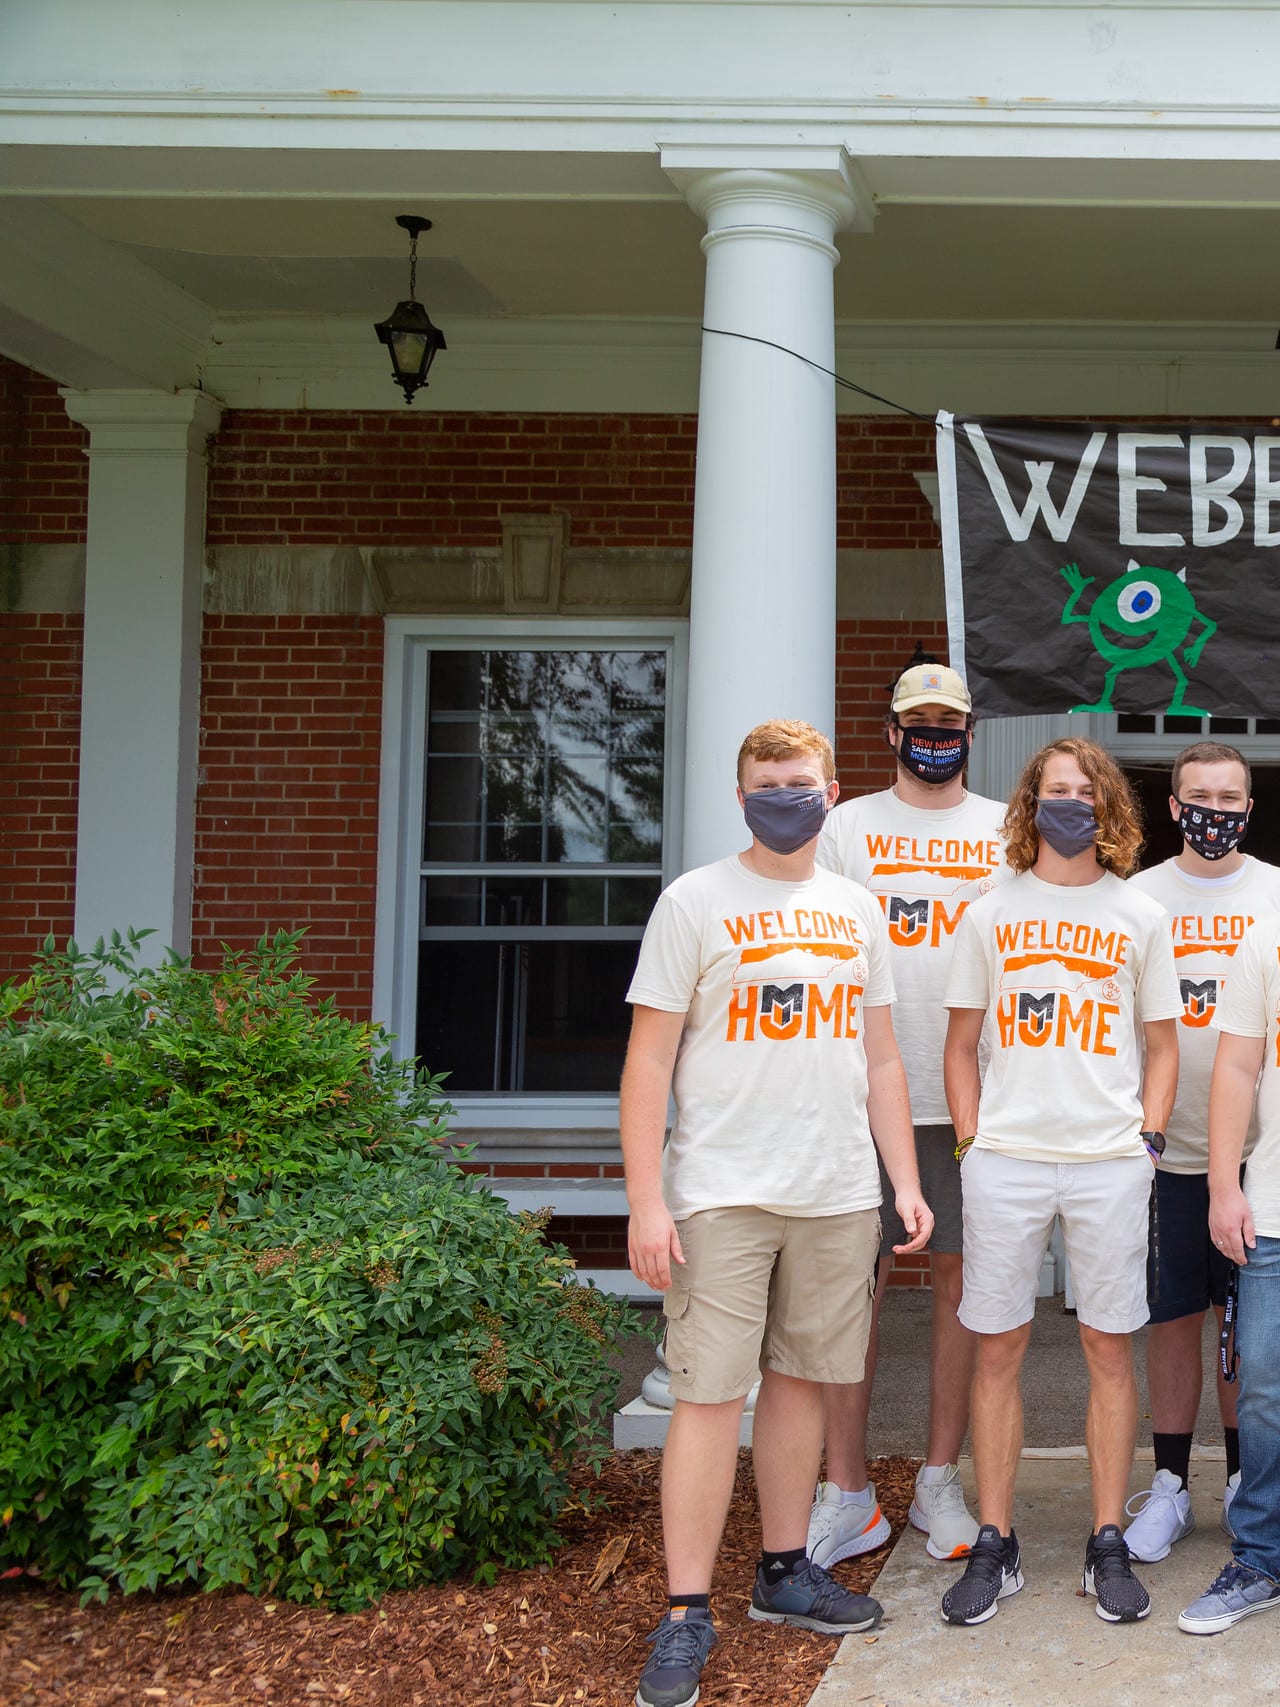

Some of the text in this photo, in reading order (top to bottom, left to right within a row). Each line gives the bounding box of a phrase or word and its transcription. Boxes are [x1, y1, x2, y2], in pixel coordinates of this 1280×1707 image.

[911, 737, 962, 749] NEW NAME
[911, 745, 961, 757] SAME MISSION
[910, 752, 961, 765] MORE IMPACT
[865, 834, 1001, 866] WELCOME
[723, 909, 865, 946] WELCOME
[1171, 915, 1255, 941] ELCO
[995, 919, 1132, 966] WELCOME
